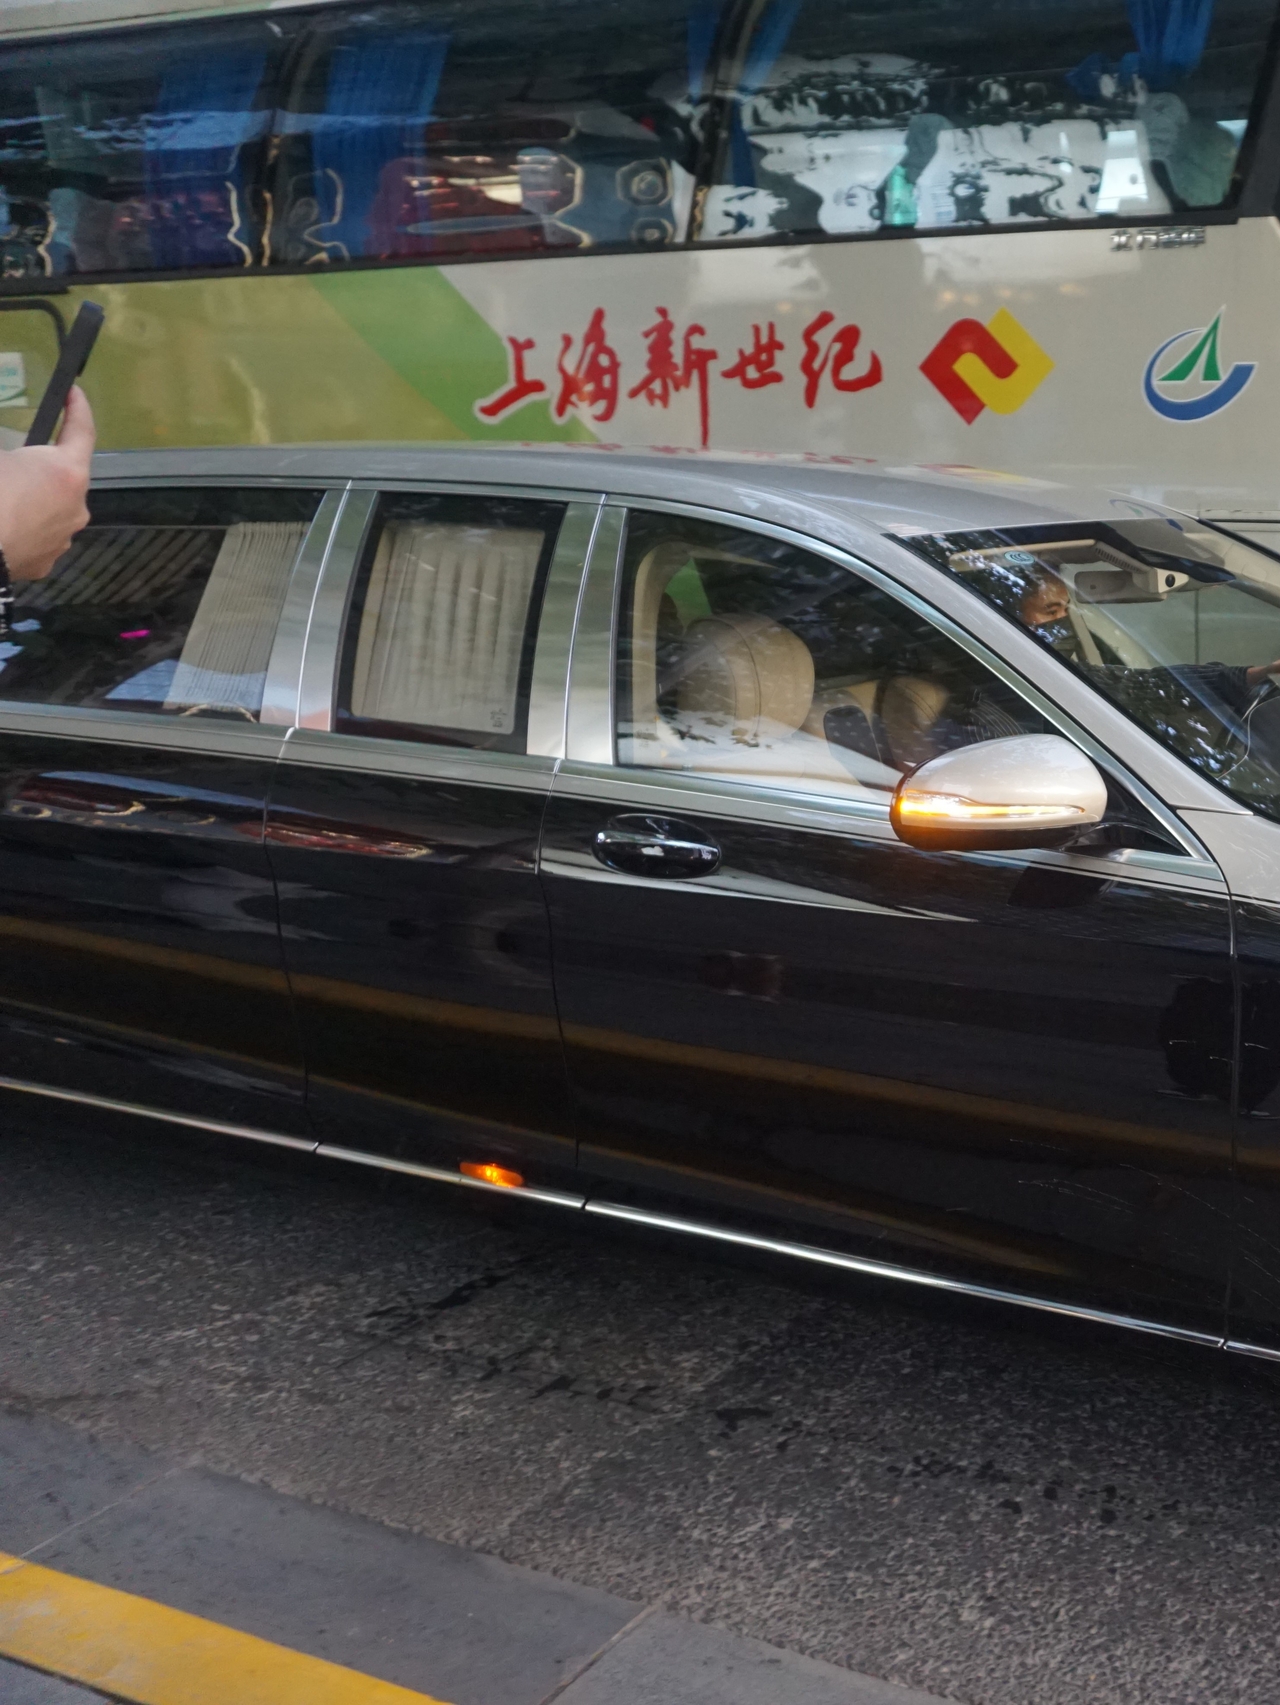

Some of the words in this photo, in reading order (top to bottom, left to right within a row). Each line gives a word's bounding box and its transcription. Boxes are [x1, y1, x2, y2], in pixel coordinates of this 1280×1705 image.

[479, 307, 883, 446] 上海新世纪
